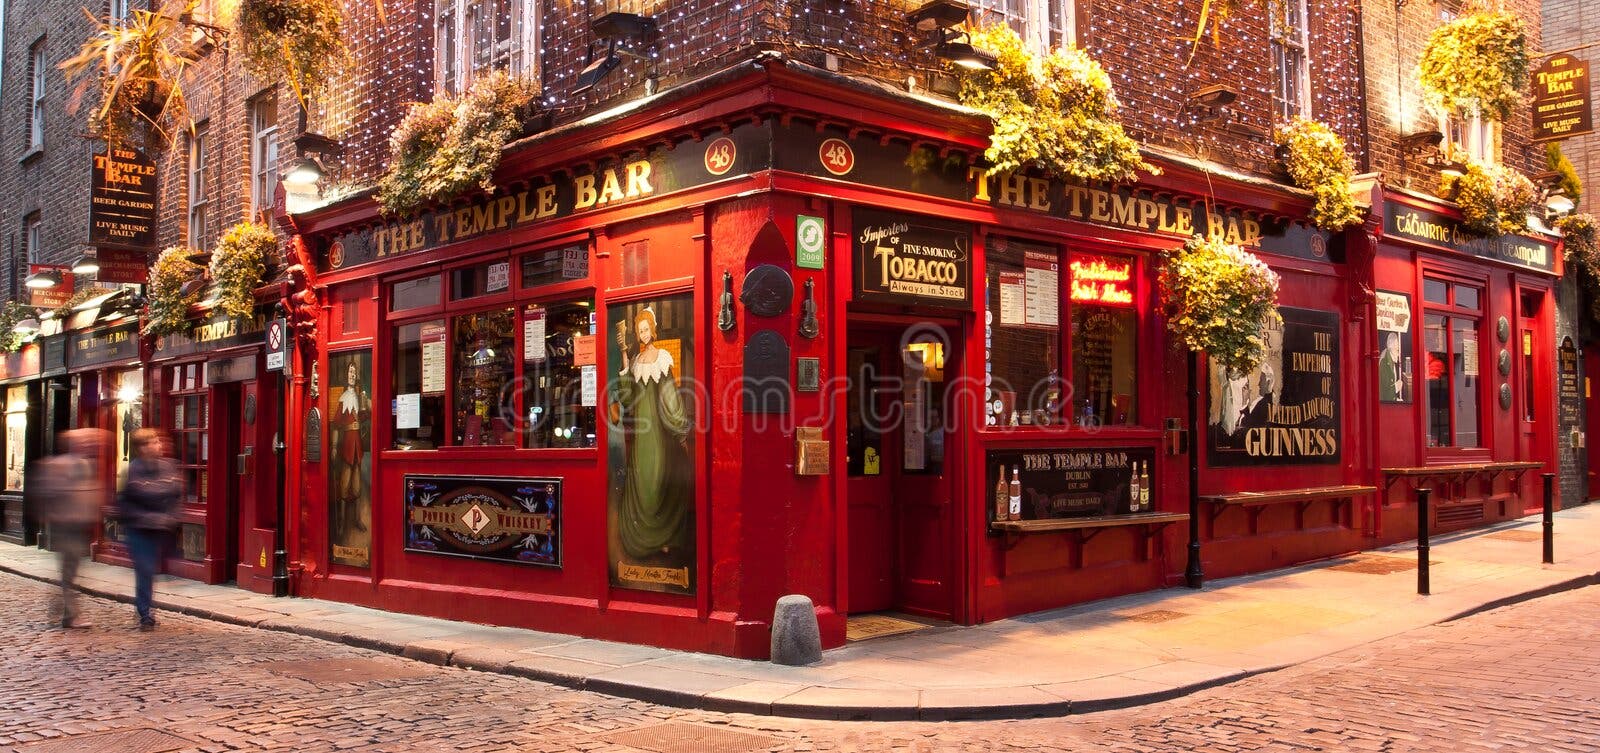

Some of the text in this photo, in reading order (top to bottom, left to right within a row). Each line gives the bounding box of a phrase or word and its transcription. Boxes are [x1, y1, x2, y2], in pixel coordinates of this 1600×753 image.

[1551, 58, 1568, 67] THE
[1537, 68, 1584, 84] TEMPLE
[1548, 81, 1574, 94] BAR
[1538, 99, 1584, 112] BEER GARDEN
[1543, 118, 1581, 129] LIVE MUSIC
[1552, 125, 1572, 133] DAILY
[115, 149, 136, 160] THE
[710, 145, 730, 169] 48
[826, 143, 847, 167] 48
[94, 155, 155, 176] TEMPLE
[106, 170, 142, 186] BAR
[93, 197, 153, 210] BEER GARDEN
[373, 159, 653, 257] THE TEMPLE BAR
[969, 167, 1263, 247] THE TEMPLE BAR
[96, 221, 149, 233] LIVE MUSIC
[109, 228, 136, 238] DAILY
[860, 222, 909, 246] Importers
[890, 236, 900, 245] OF
[800, 252, 820, 262] 2009
[903, 243, 957, 259] FINE SMOKING
[873, 246, 957, 287] TOBACCO
[891, 281, 923, 294] Always
[939, 286, 964, 297] Stock
[115, 330, 129, 343] BAR
[194, 319, 238, 343] TEMPLE
[241, 314, 266, 335] BAR
[1313, 331, 1331, 351] THE
[1292, 352, 1332, 373] EMPEROR
[1321, 376, 1331, 395] OF
[1267, 397, 1335, 424] MALTED LIQUORS
[1245, 427, 1337, 457] GUINNESS
[1023, 452, 1129, 470] THE TEMPLE BAR
[1065, 471, 1091, 481] DUBLIN
[471, 508, 482, 531] P
[497, 513, 542, 530] WHISKEY
